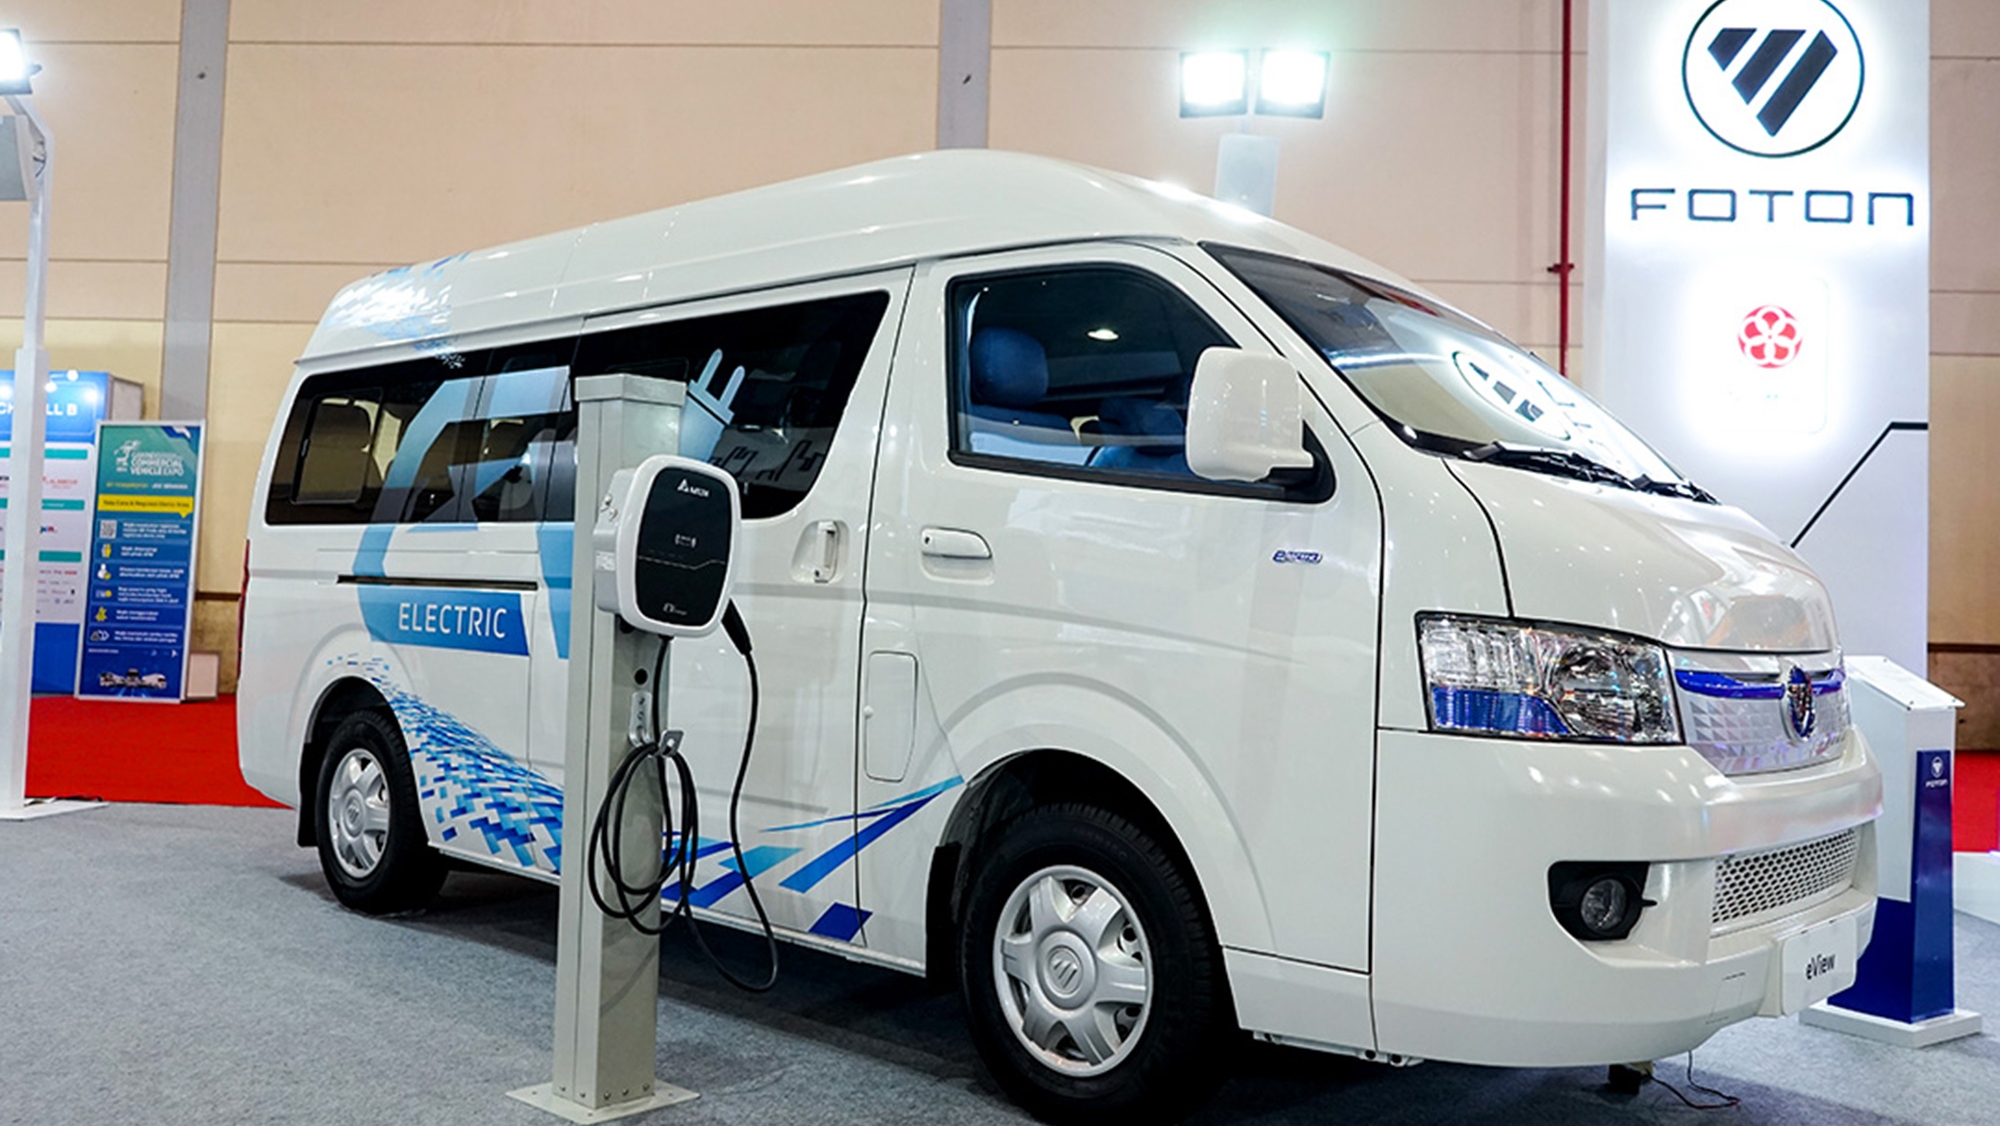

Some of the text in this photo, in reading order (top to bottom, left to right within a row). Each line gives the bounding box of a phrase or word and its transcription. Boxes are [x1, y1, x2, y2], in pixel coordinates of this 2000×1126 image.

[1630, 188, 1914, 226] FOTON
[398, 602, 507, 638] ELECTRIC
[1806, 953, 1836, 980] eView
